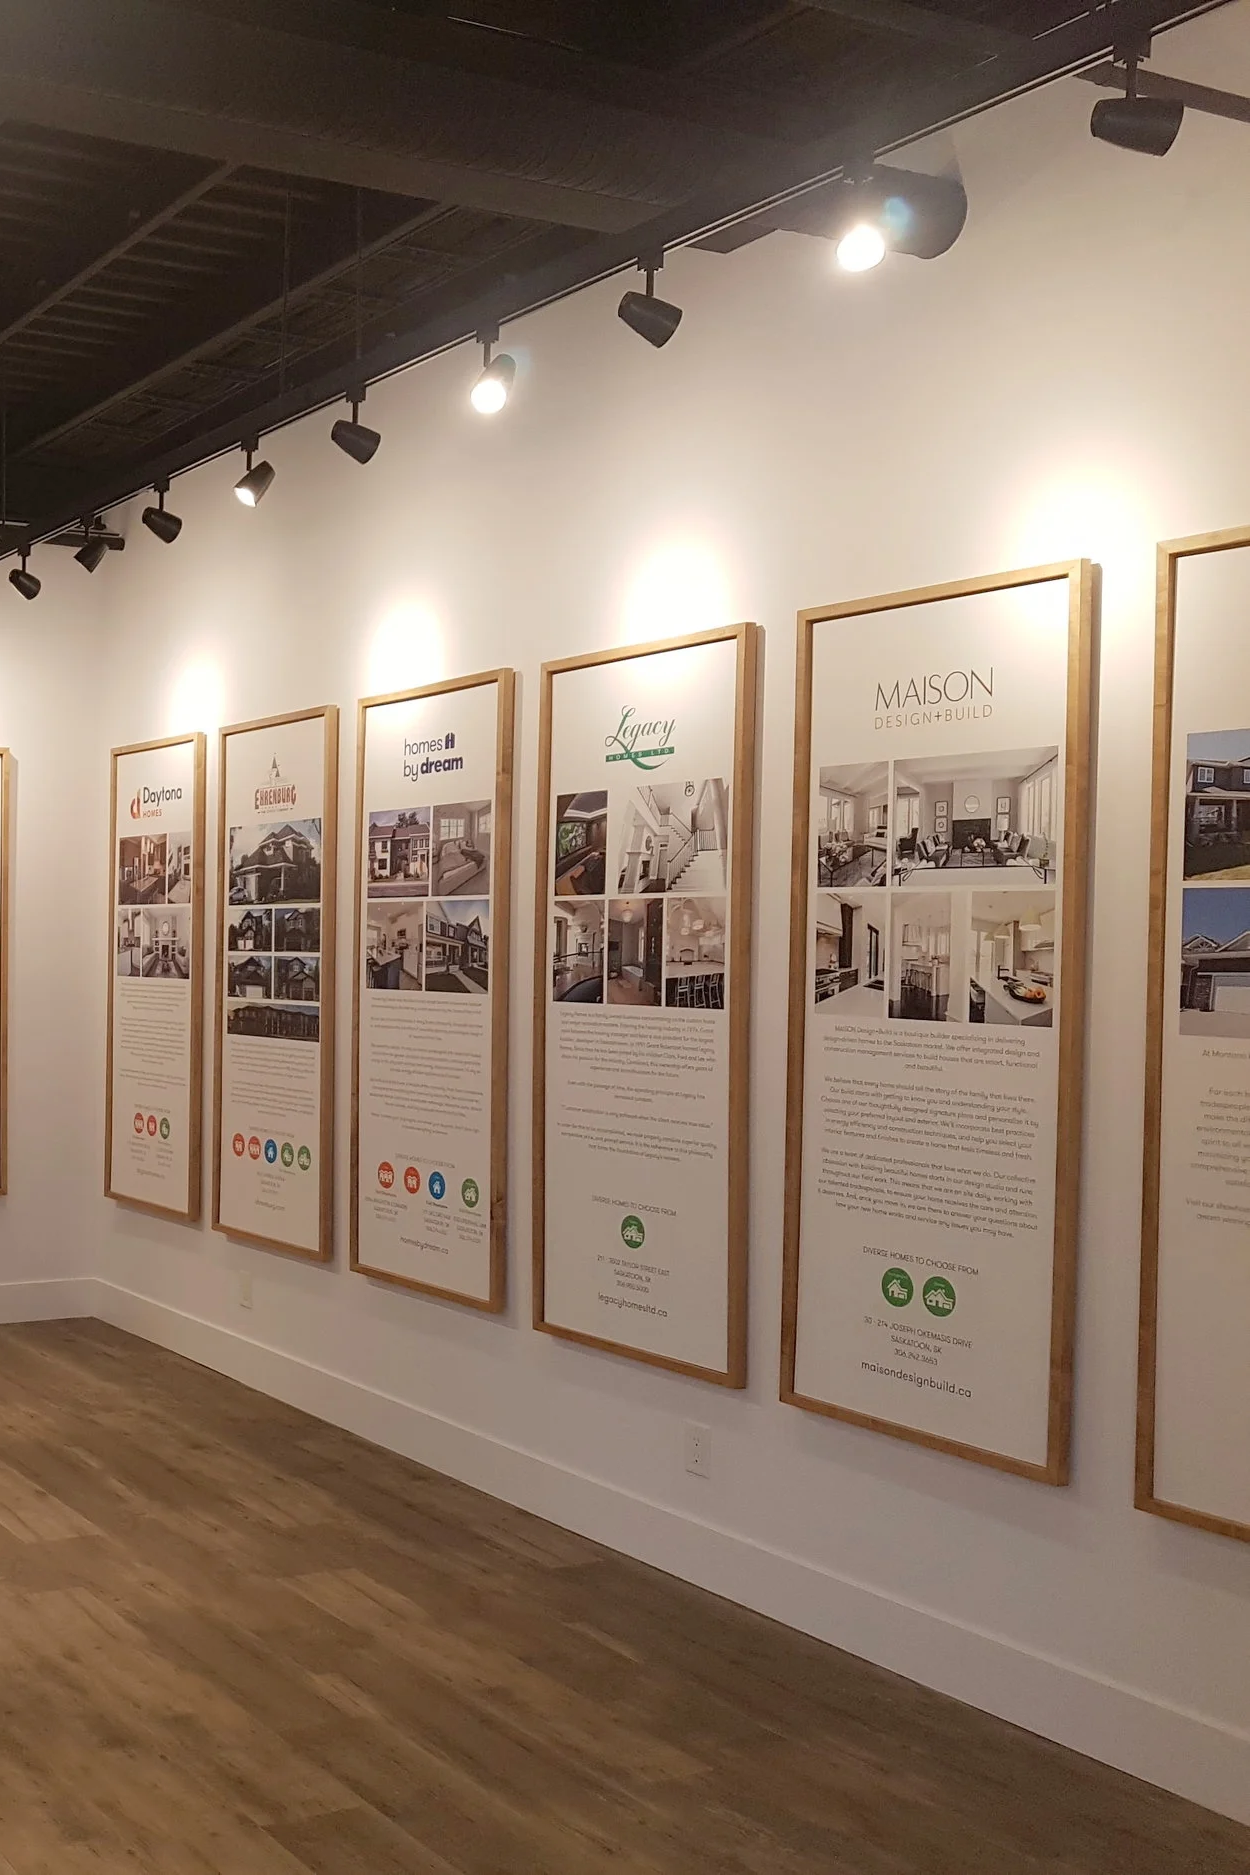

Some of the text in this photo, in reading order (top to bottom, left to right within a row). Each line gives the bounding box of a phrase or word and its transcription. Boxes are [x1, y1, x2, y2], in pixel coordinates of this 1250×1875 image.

[875, 667, 993, 711] MAISON
[605, 705, 676, 753] Legacy
[874, 704, 993, 730] DESIGN+BUILD
[404, 738, 443, 756] homes
[403, 756, 464, 782] by dream
[143, 786, 182, 807] Daytona
[905, 1213, 917, 1221] and
[969, 1225, 982, 1233] you
[863, 1246, 979, 1276] DIVERSE HOMES TO CHOOSE FROM
[598, 1292, 668, 1318] legacyhomesltd.ca
[889, 1323, 916, 1336] JOSEPH
[917, 1328, 951, 1345] OKEMASIS
[952, 1337, 973, 1350] DRIVE
[891, 1335, 932, 1353] SASKATOON,
[861, 1361, 972, 1398] maisondesignbuild.ca
